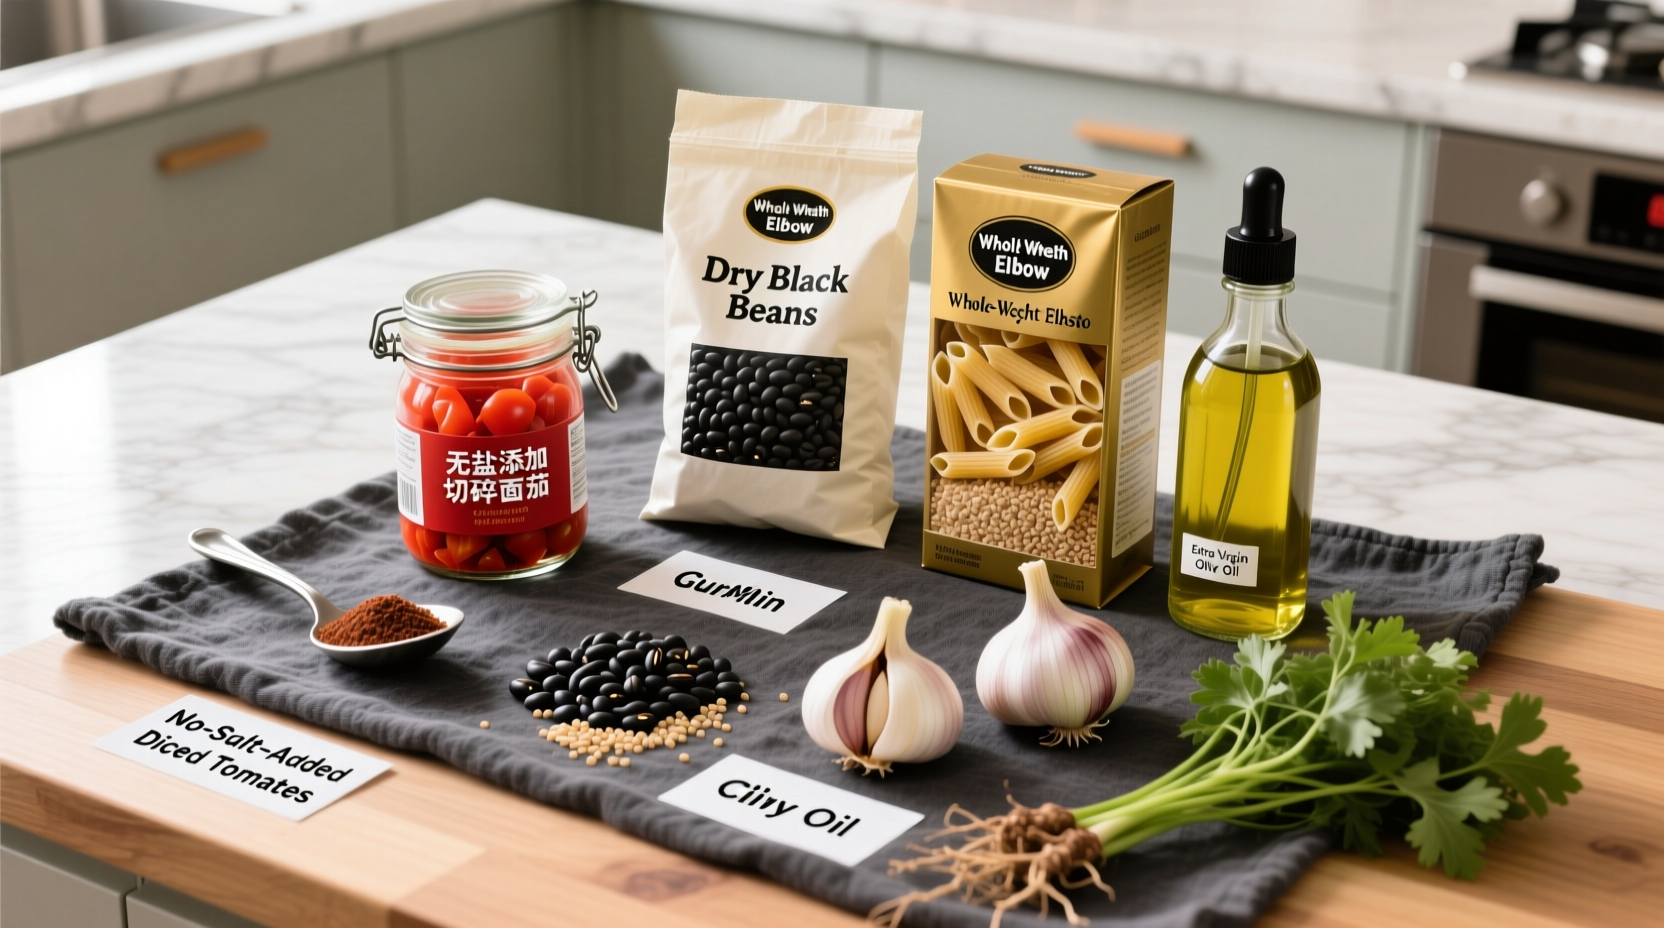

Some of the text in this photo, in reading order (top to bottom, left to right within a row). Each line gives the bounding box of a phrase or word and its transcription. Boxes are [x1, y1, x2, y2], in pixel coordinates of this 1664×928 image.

[765, 216, 814, 235] Elbow
[702, 255, 850, 295] Dry Black
[994, 254, 1050, 281] Elbow
[725, 294, 818, 326] Beans
[445, 446, 548, 476] 无盐添加
[164, 708, 354, 783] No-Salt-Added
[133, 729, 315, 804] Diced Tomates
[803, 807, 861, 837] Oil
